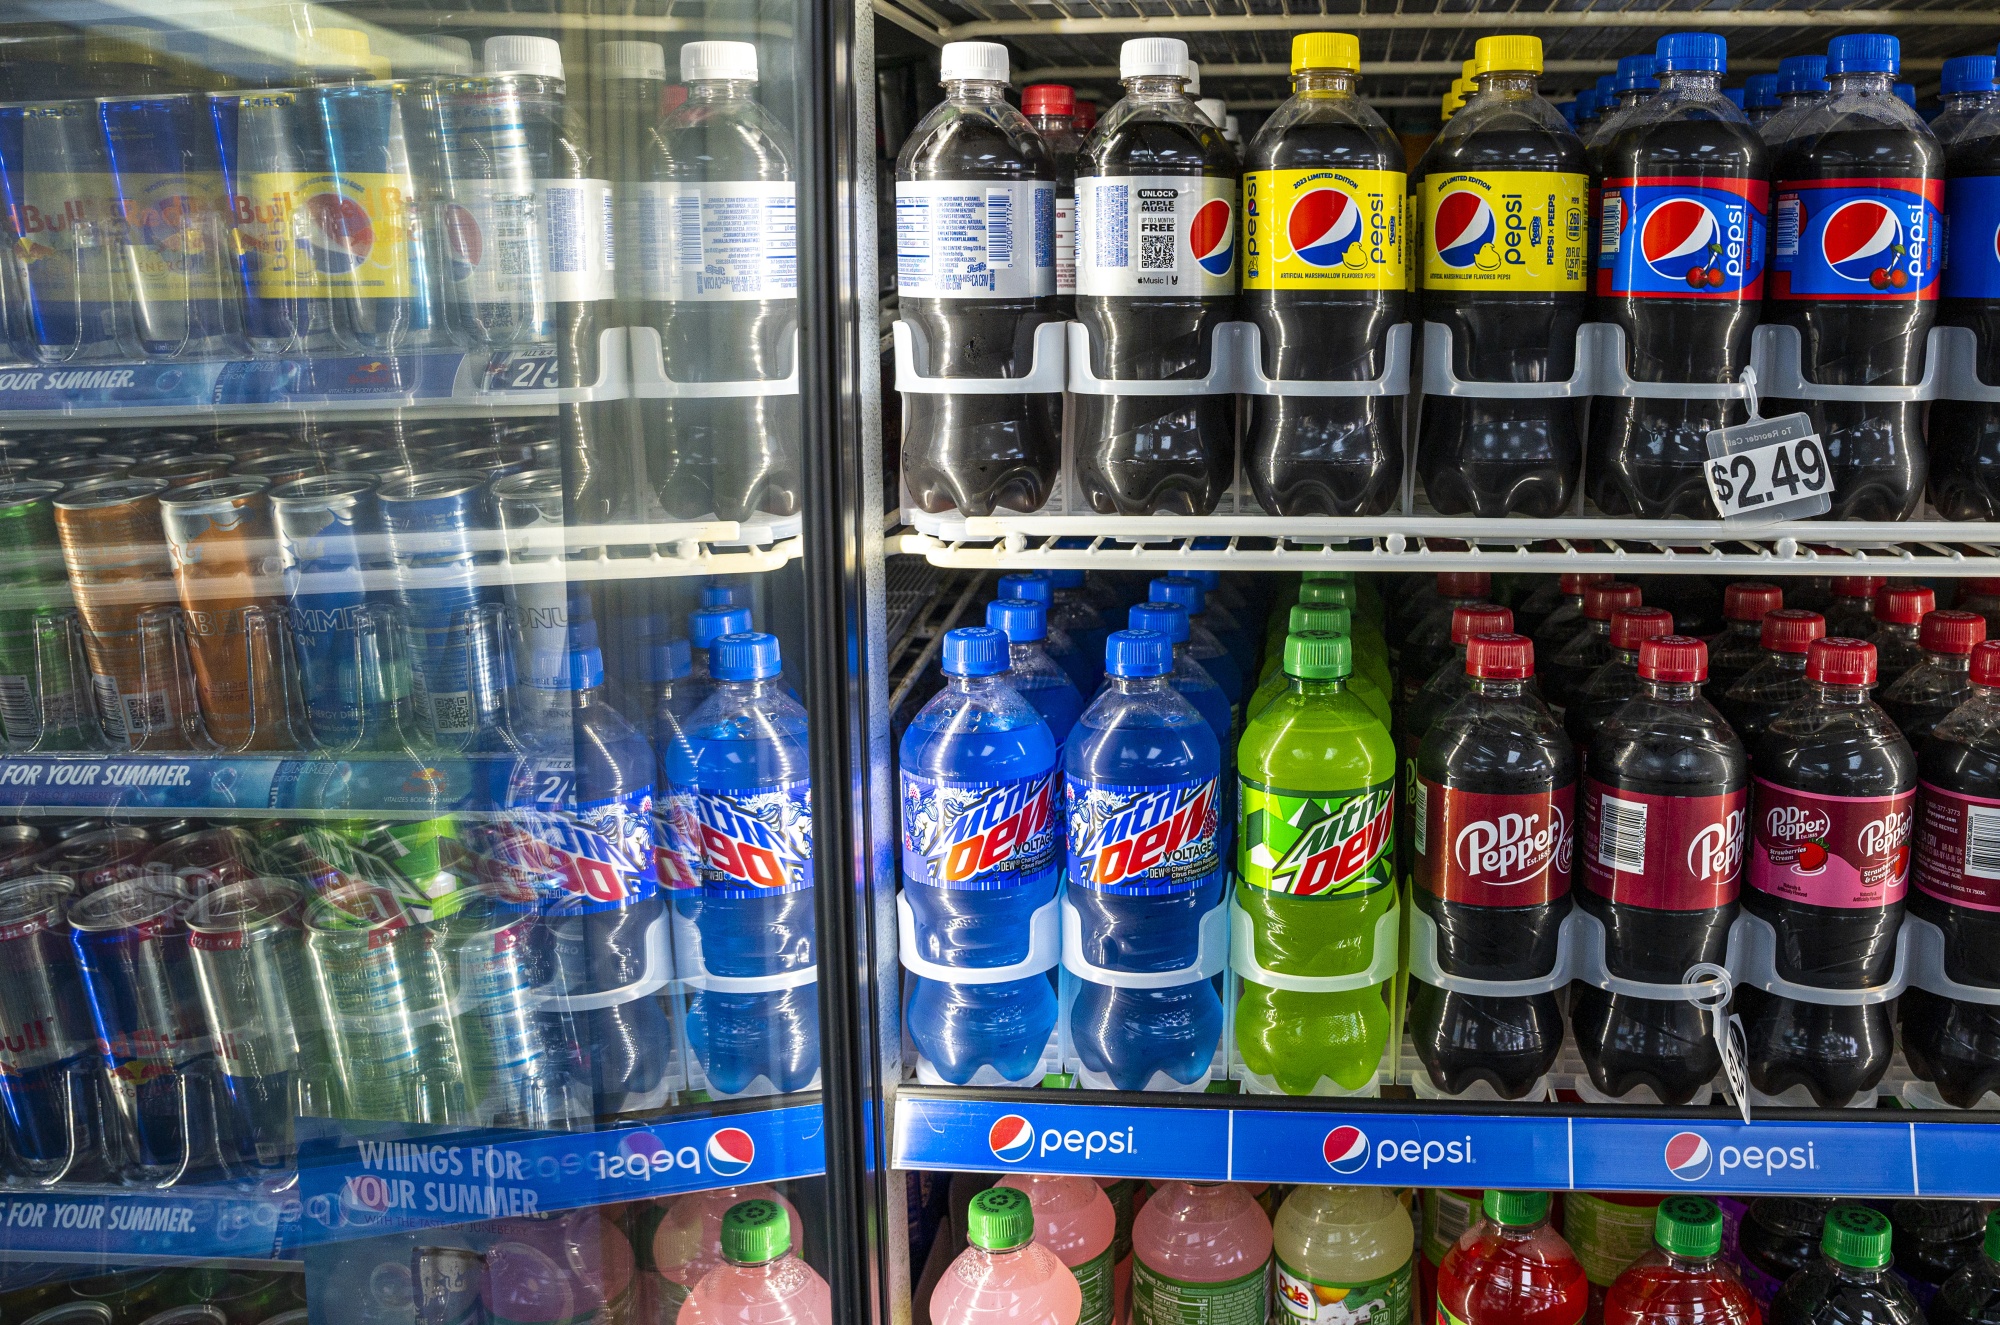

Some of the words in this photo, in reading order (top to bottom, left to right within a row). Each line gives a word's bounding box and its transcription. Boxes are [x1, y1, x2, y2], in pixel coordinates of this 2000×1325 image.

[1141, 190, 1175, 198] UNLOCK
[1293, 177, 1307, 190] 2023
[1307, 172, 1334, 182] LIMITED
[1334, 173, 1359, 190] EDITION
[1446, 175, 1468, 185] LIMITED
[1467, 175, 1492, 192] EDITION
[1246, 175, 1260, 256] pepsi
[1547, 194, 1556, 227] PEEPS
[1569, 213, 1580, 226] 260
[1367, 192, 1387, 264] pepsi
[1501, 193, 1527, 266] pepsi
[1530, 215, 1542, 248] Peeps
[1613, 208, 1621, 246] 125590
[1725, 204, 1744, 277] pepsi
[1791, 212, 1799, 246] 125590
[1907, 204, 1926, 277] pepsi
[1546, 235, 1555, 266] PEPSI
[1565, 247, 1572, 257] 20
[1143, 277, 1164, 285] Music
[1566, 269, 1574, 281] 591
[44, 369, 135, 391] SUMMER.
[1710, 439, 1827, 509] $2.49
[0, 765, 43, 786] FOR
[45, 765, 101, 786] YOUR
[101, 765, 192, 786] SUMMER.
[1497, 812, 1540, 848] Dr
[1770, 807, 1826, 842] Pepper
[1785, 806, 1810, 823] Dr
[1884, 811, 1905, 836] Dr
[1938, 824, 1959, 834] RECYCLE
[1163, 840, 1212, 863] VOLTAGE
[1460, 819, 1560, 878] Pepper
[1769, 847, 1807, 856] Strawberries
[1866, 815, 1912, 858] Pepper
[1171, 864, 1193, 873] Charged
[1171, 870, 1187, 879] Citrus
[1187, 866, 1201, 876] Flavor
[1863, 854, 1902, 877] Strawberries
[1040, 1125, 1135, 1160] pepsi
[1376, 1134, 1473, 1170] pepsi
[1719, 1140, 1817, 1176] pepsi
[357, 1139, 464, 1177] WIIINGS
[470, 1145, 524, 1181] FOR
[344, 1175, 417, 1210] YOUR
[423, 1181, 549, 1220] SUMMER.
[6, 1202, 47, 1228] FOR
[53, 1203, 105, 1230] YOUR
[107, 1205, 197, 1233] SUMMER.
[364, 1214, 393, 1226] WITH
[395, 1216, 416, 1228] THE
[419, 1218, 447, 1230] TASTE
[450, 1220, 466, 1231] OF
[468, 1222, 529, 1237] JUNEBERRY
[1165, 1283, 1182, 1294] JUICE
[1279, 1272, 1309, 1305] Dole
[1142, 1313, 1153, 1325] 110
[1373, 1311, 1389, 1325] 270
